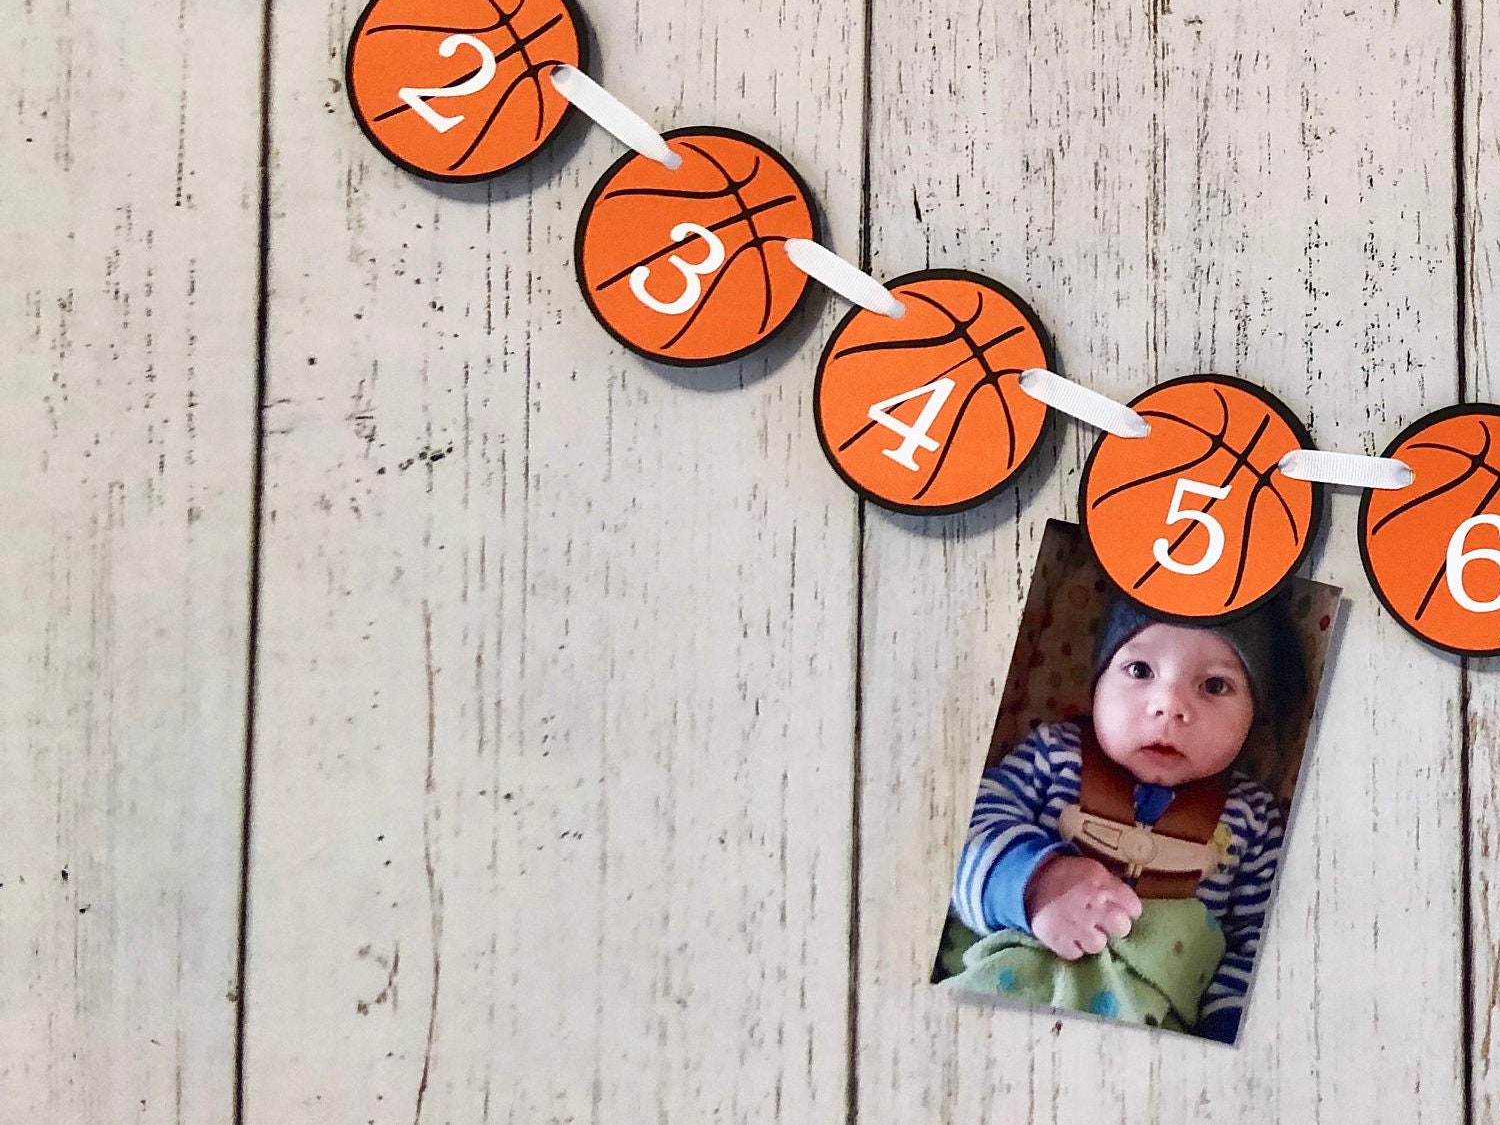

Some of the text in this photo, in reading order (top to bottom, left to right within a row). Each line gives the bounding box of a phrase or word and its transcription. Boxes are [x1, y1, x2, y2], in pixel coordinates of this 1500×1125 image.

[398, 34, 497, 133] 2
[629, 222, 725, 315] 3
[867, 377, 956, 472] 4
[1152, 478, 1232, 575] 5
